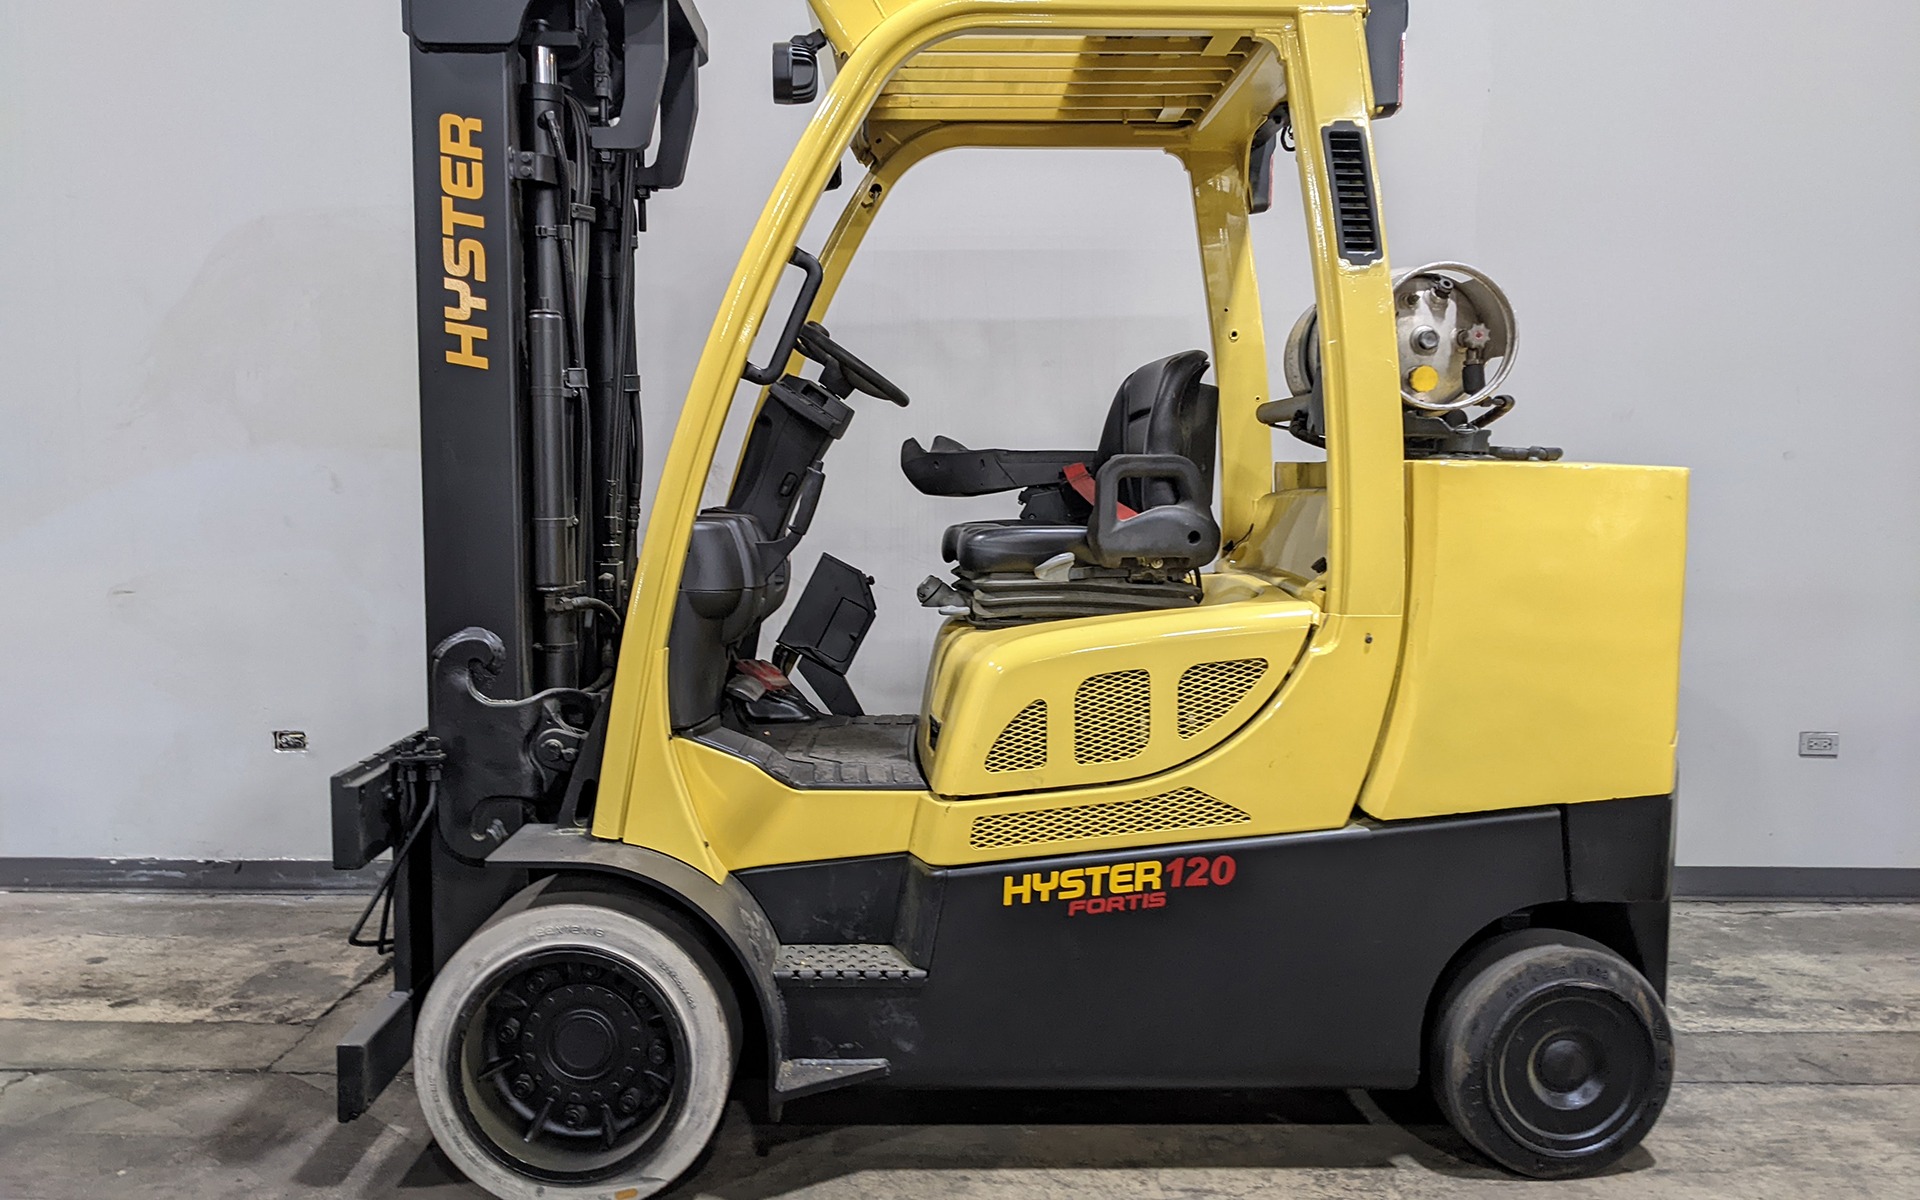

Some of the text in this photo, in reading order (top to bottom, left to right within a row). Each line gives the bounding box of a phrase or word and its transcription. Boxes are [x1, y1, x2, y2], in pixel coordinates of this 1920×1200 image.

[439, 113, 489, 370] HYSTER
[1002, 855, 1236, 906] HYSTER 120
[1068, 891, 1166, 916] FORTIS
